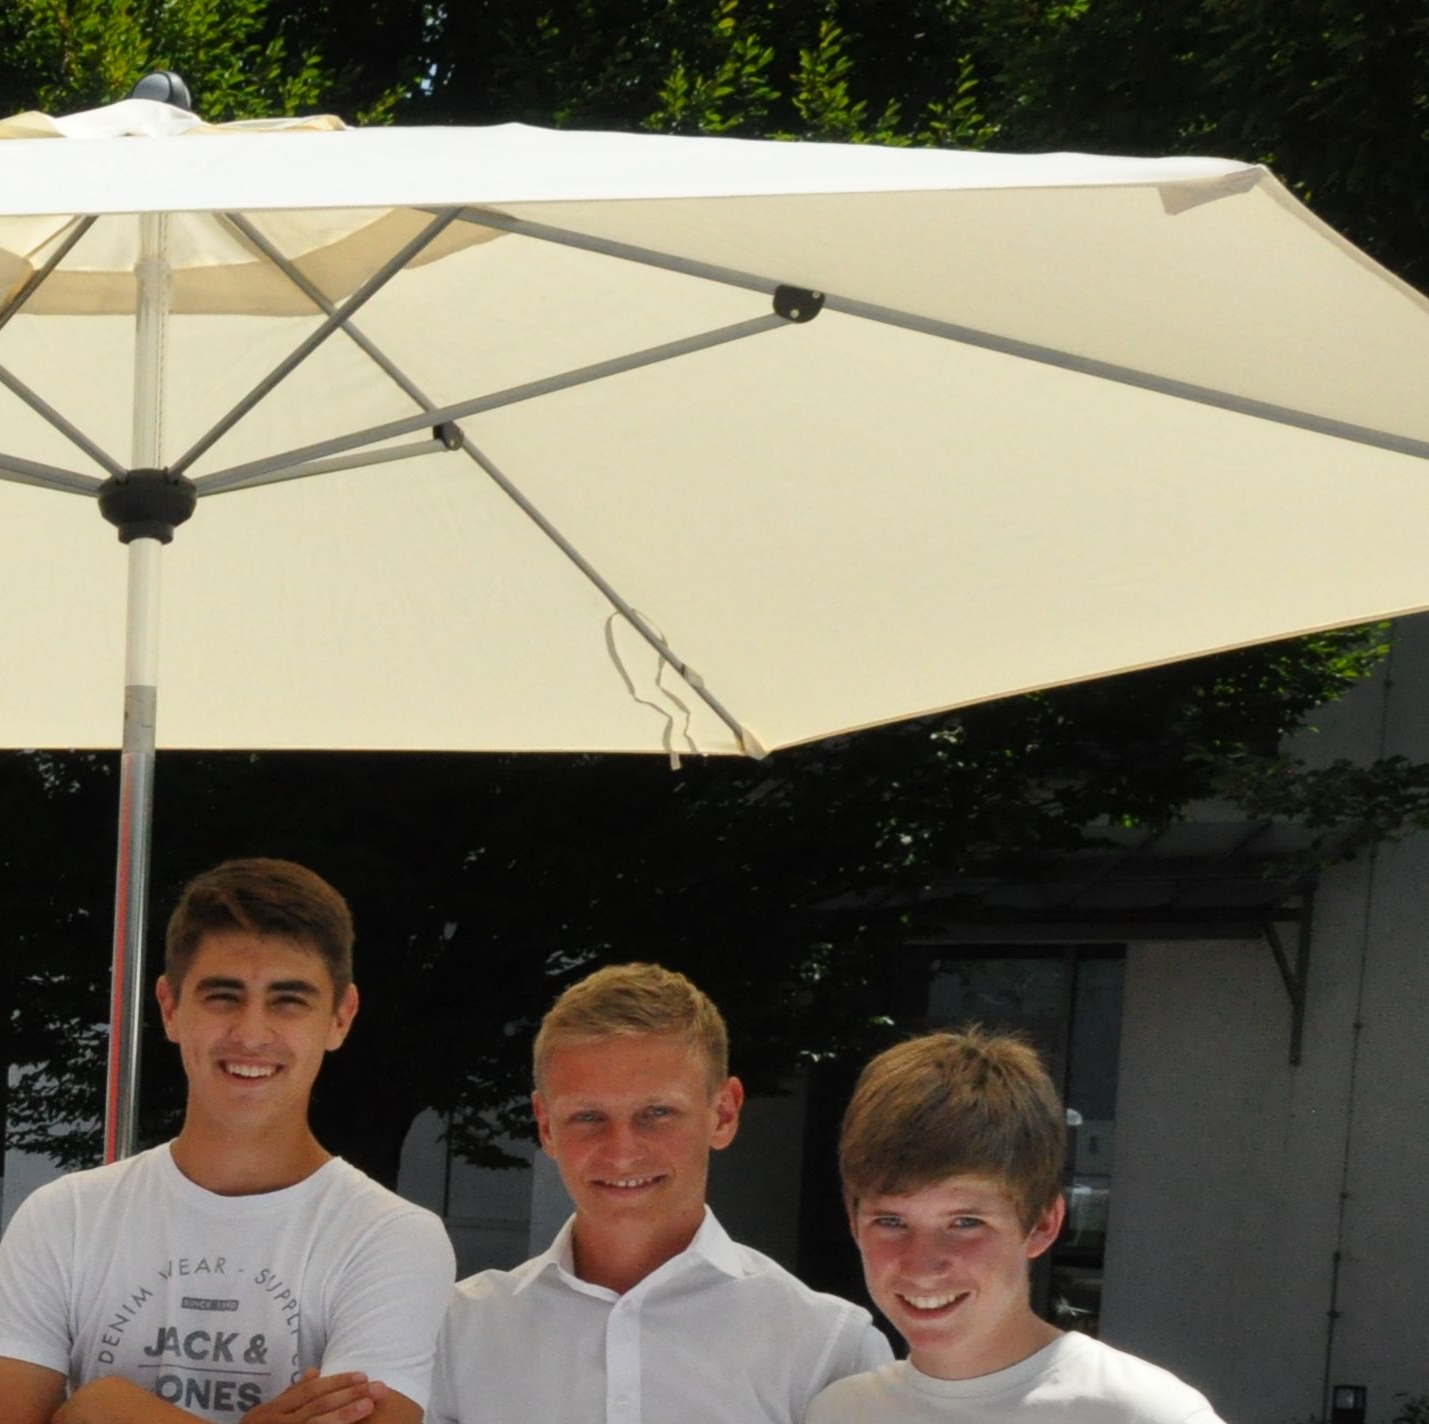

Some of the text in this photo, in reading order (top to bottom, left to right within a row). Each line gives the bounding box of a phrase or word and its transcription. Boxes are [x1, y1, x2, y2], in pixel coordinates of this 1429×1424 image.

[97, 1287, 153, 1365] DENIM
[143, 1326, 268, 1364] JACK &
[154, 1374, 262, 1412] ONES
